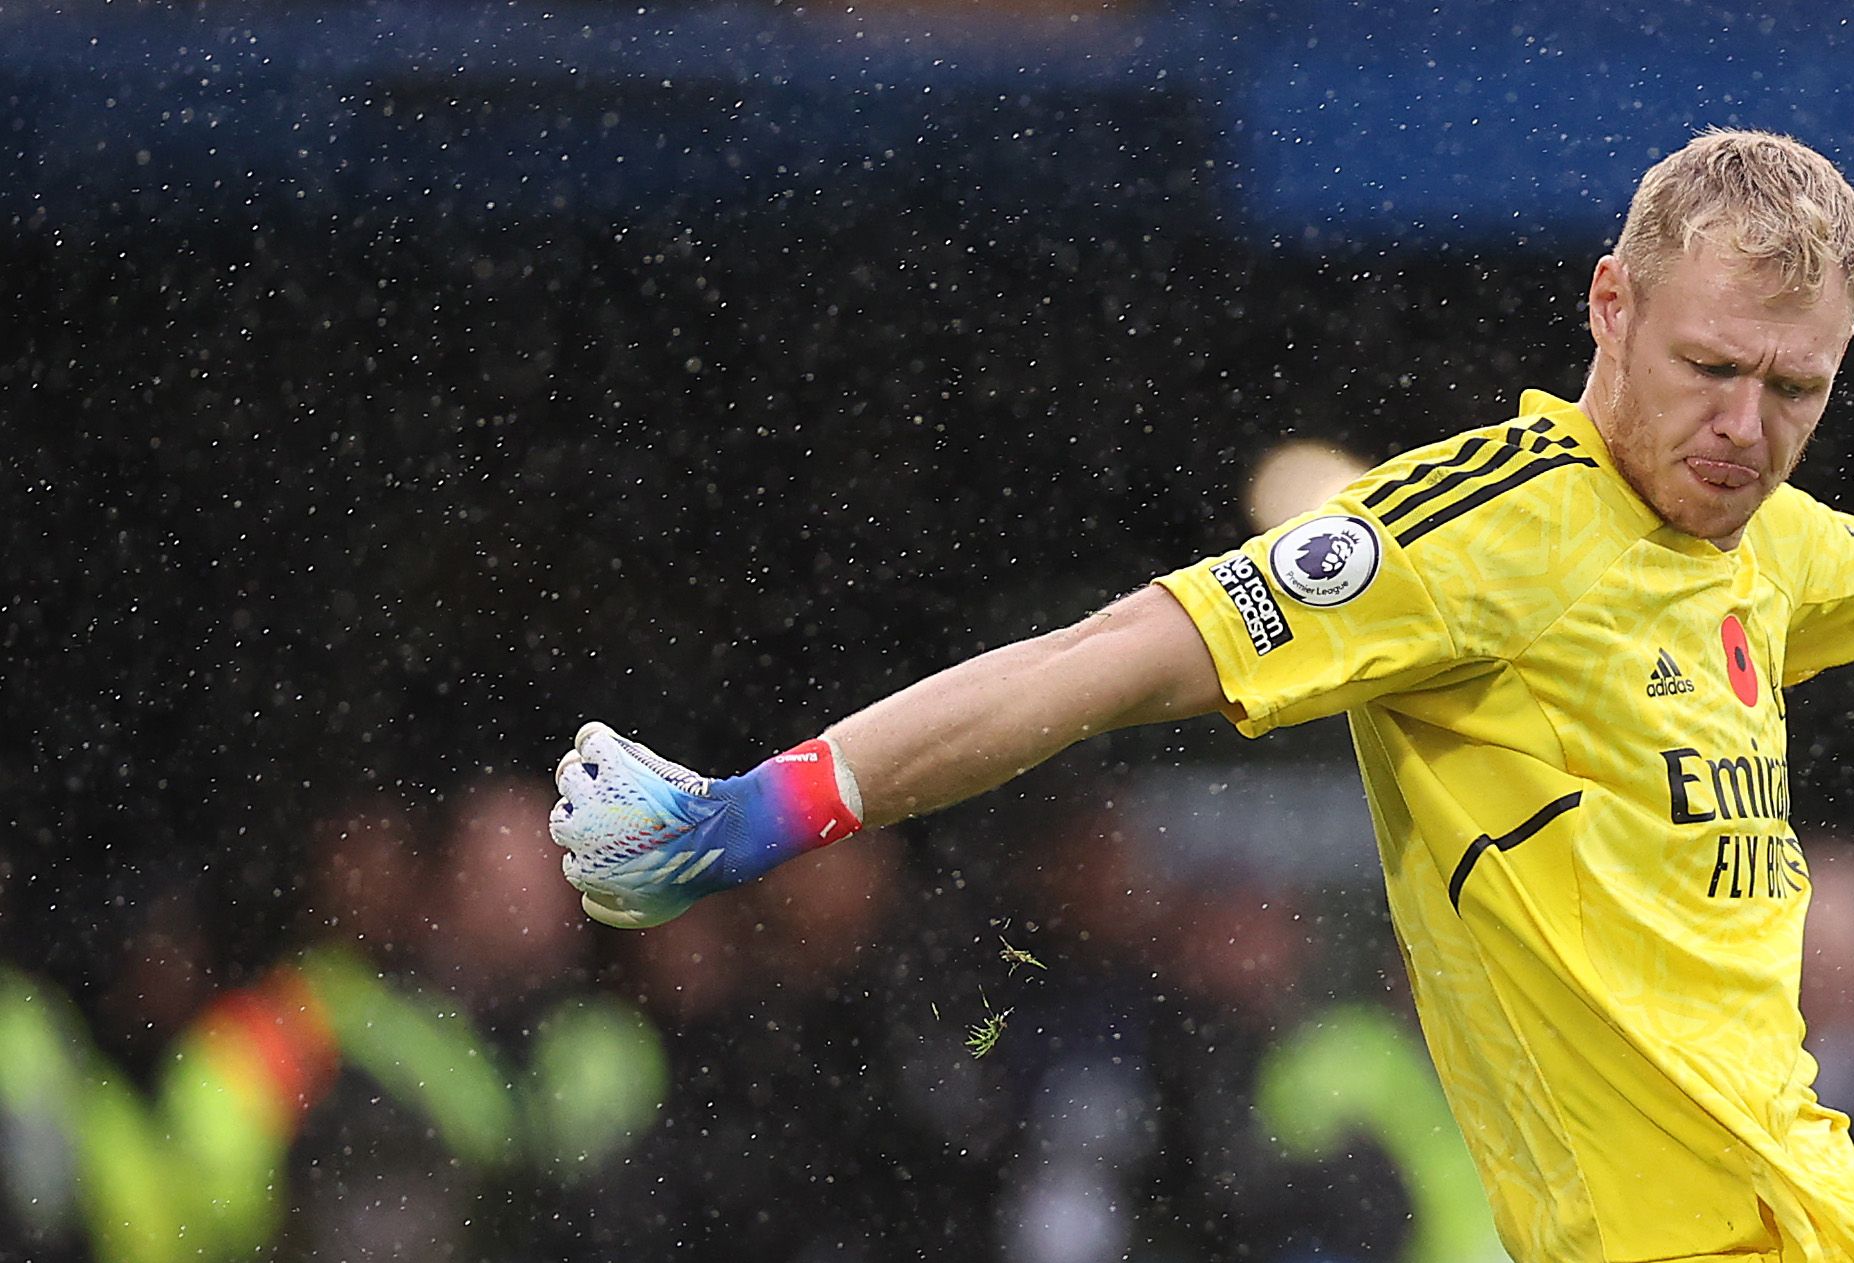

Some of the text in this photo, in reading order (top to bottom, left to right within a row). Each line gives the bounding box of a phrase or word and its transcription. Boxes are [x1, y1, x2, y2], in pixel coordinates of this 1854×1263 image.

[1210, 561, 1272, 655] for racism
[1228, 555, 1283, 638] No room
[1286, 570, 1349, 595] Premier League
[1646, 677, 1695, 698] adidas
[1707, 835, 1758, 899] FLY
